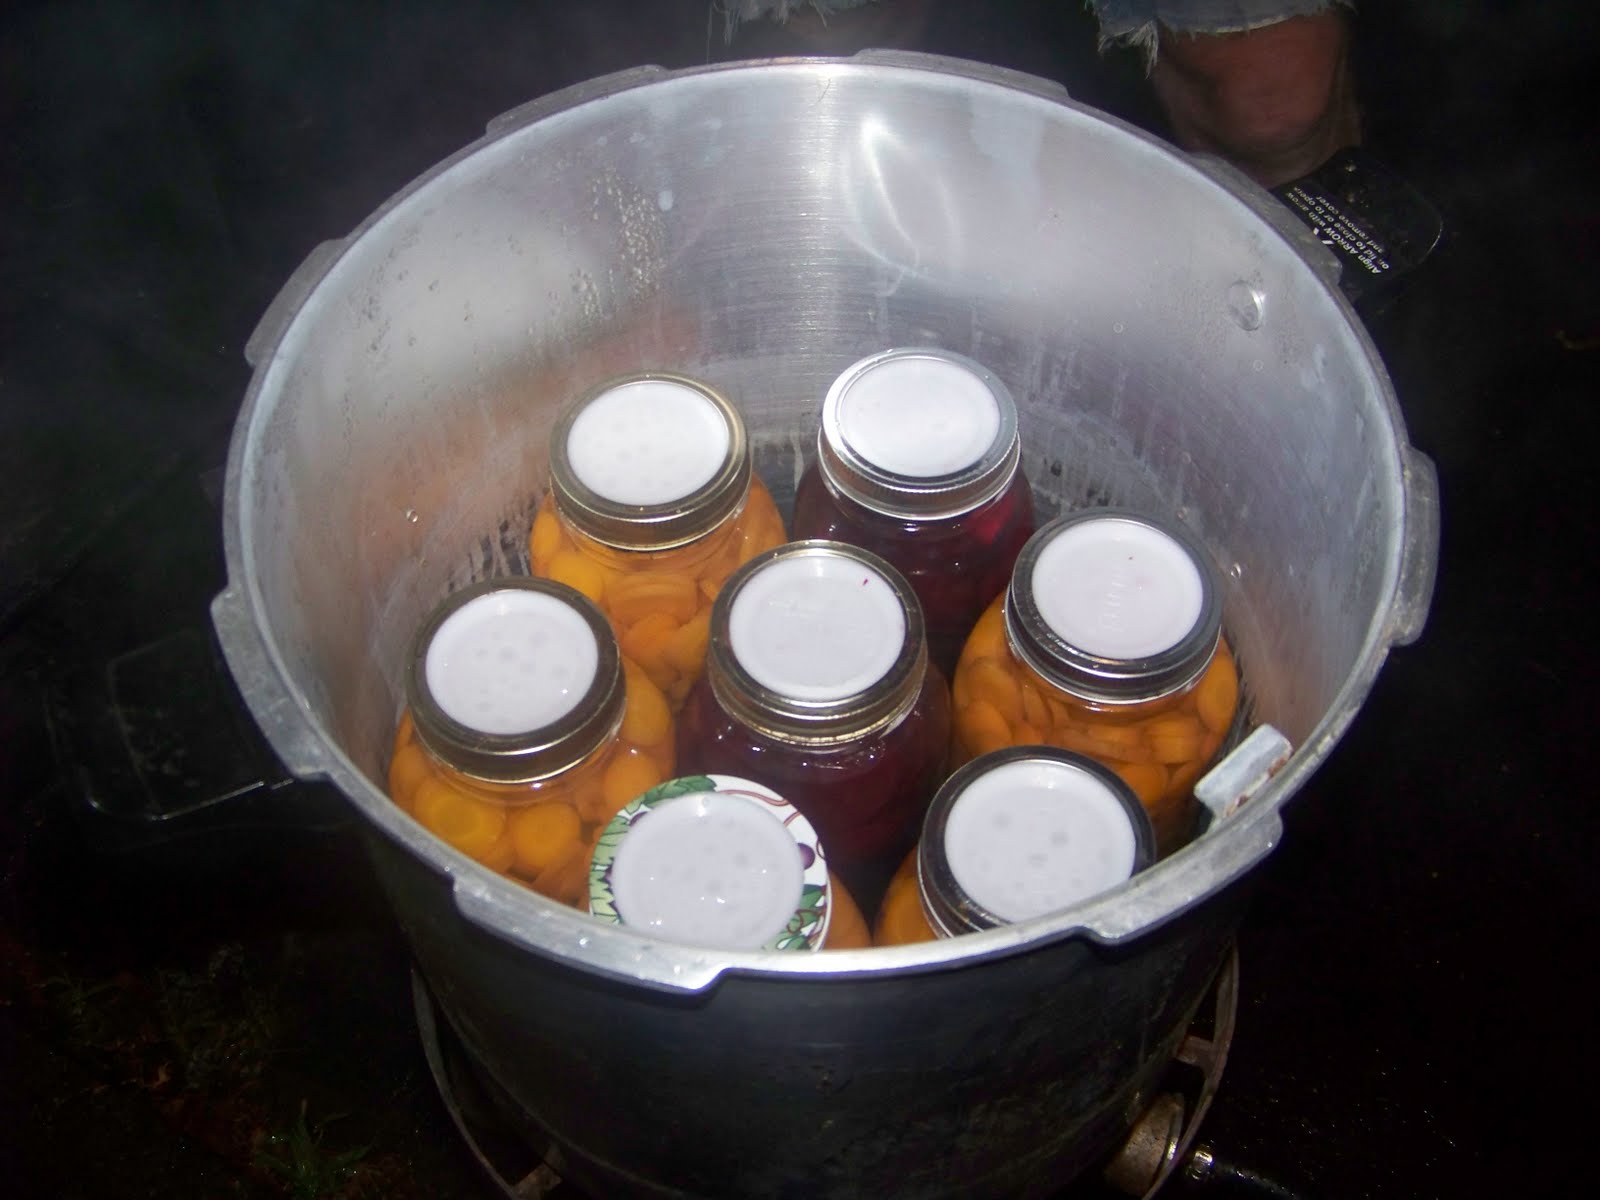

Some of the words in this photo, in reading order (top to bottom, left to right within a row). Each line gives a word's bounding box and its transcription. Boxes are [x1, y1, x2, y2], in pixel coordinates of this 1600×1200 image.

[1314, 205, 1325, 215] to
[1315, 196, 1339, 215] cover
[1308, 211, 1326, 227] with
[1323, 214, 1335, 223] or
[1333, 222, 1357, 242] close
[1323, 227, 1359, 254] ARROW
[1355, 241, 1366, 250] to
[1366, 239, 1383, 254] and
[1363, 249, 1377, 262] lid
[1357, 254, 1382, 274] Align
